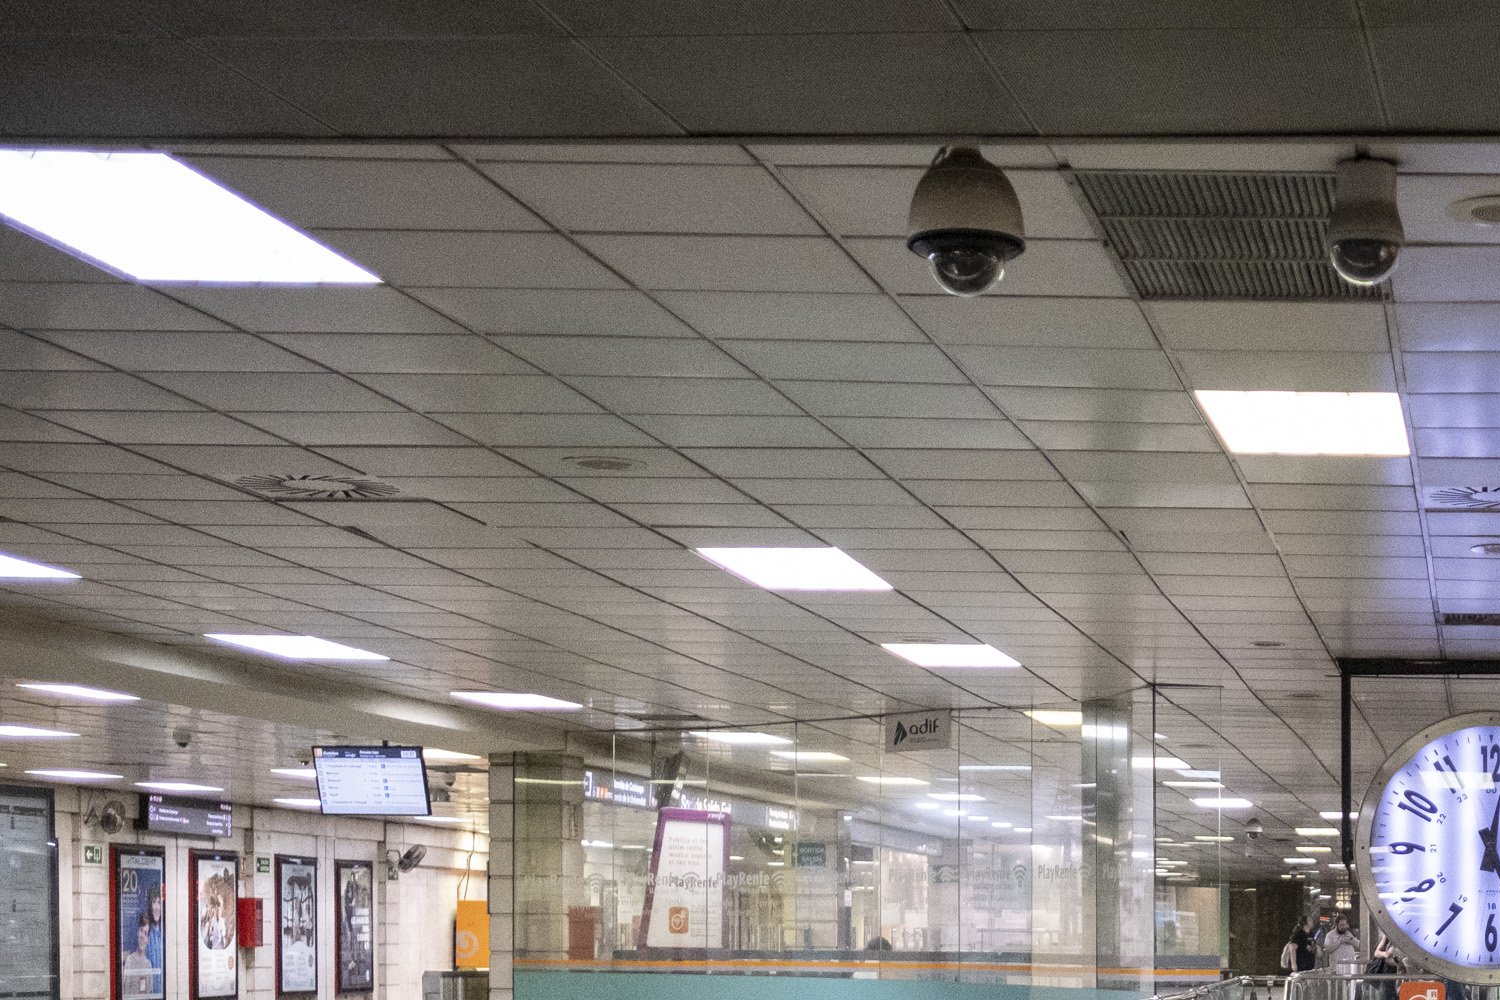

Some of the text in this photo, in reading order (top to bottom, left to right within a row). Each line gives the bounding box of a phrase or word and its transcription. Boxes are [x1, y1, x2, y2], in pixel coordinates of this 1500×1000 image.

[908, 718, 940, 736] adif
[1432, 755, 1466, 794] 11
[1456, 793, 1469, 804] 23
[1397, 789, 1439, 823] 10
[1436, 813, 1447, 825] 22
[1387, 841, 1426, 855] 9
[1429, 843, 1437, 854] 21
[122, 869, 138, 893] 20
[1436, 872, 1447, 884] 20
[1458, 894, 1469, 904] 19
[1486, 902, 1498, 911] 18
[1435, 902, 1464, 937] 7
[1484, 913, 1498, 953] 6
